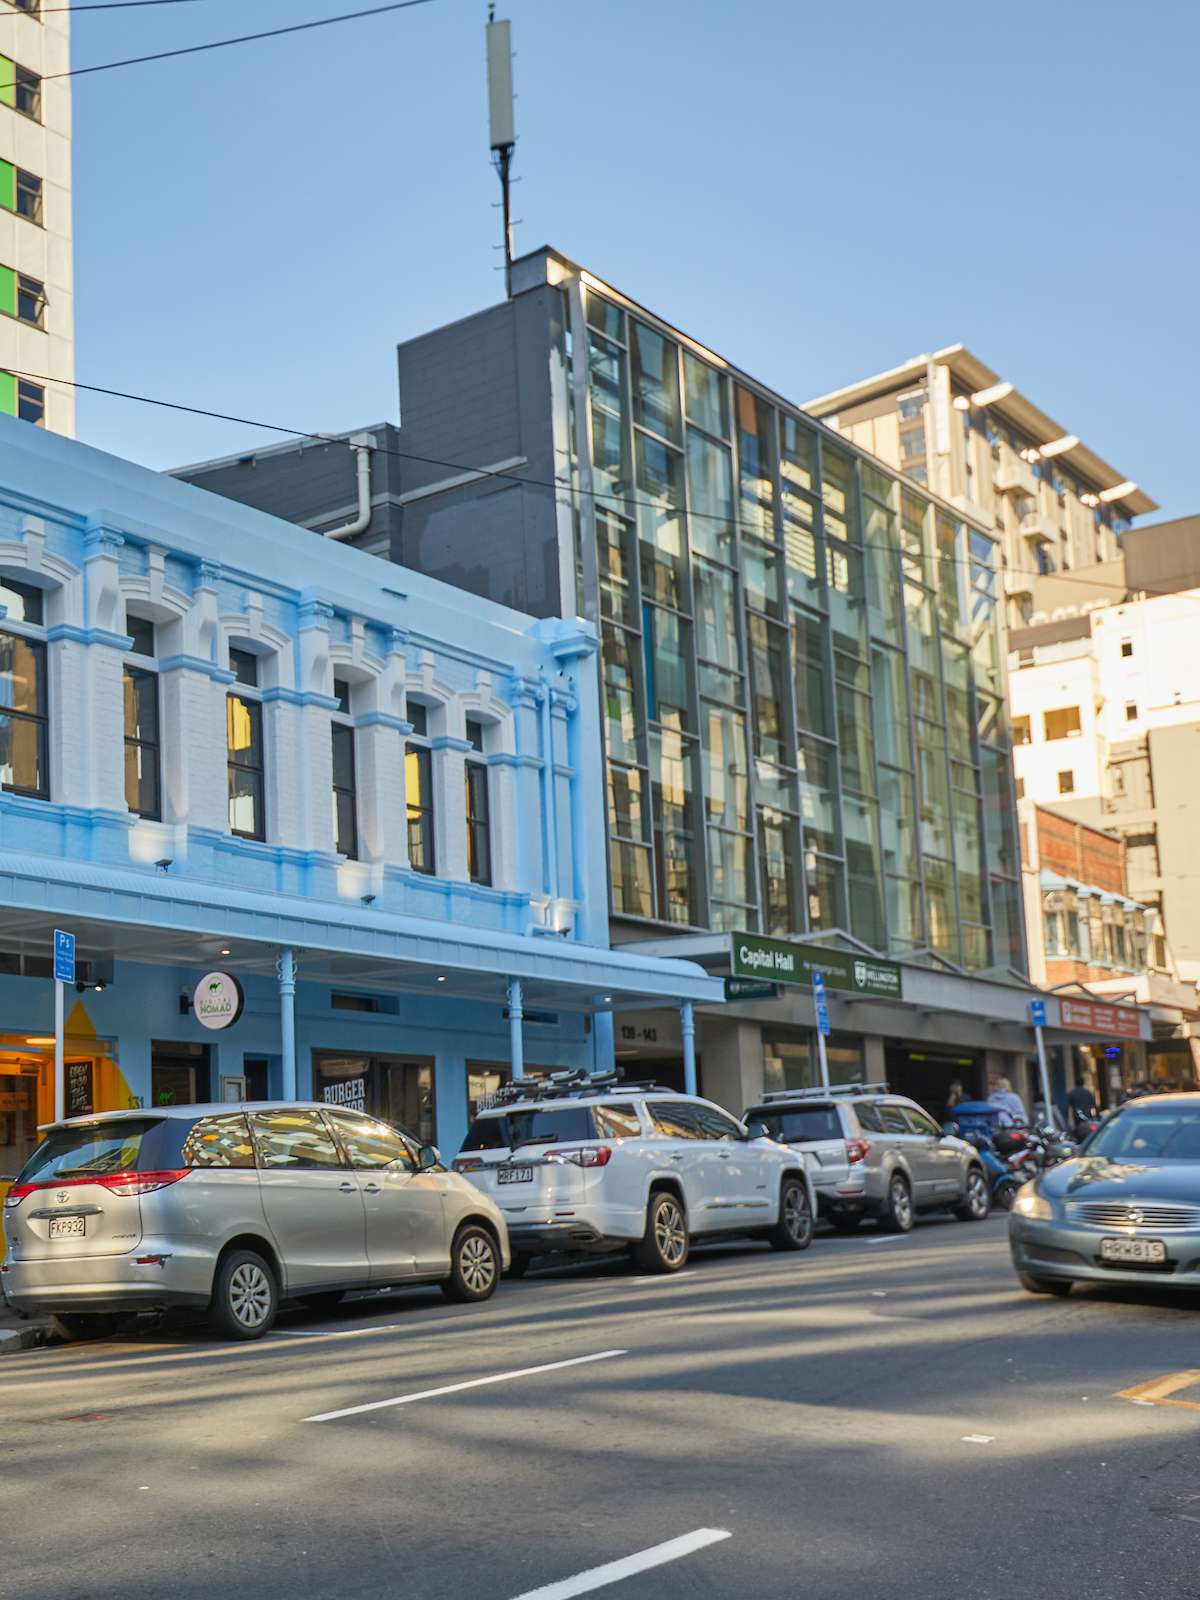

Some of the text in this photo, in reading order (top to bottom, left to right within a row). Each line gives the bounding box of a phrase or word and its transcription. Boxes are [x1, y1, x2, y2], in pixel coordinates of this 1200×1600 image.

[740, 946, 774, 970] Capital
[775, 952, 794, 971] Hall
[200, 1002, 231, 1014] NOMAD
[324, 1078, 365, 1104] BURGER
[128, 1095, 144, 1109] 131
[51, 1220, 83, 1234] FKP932
